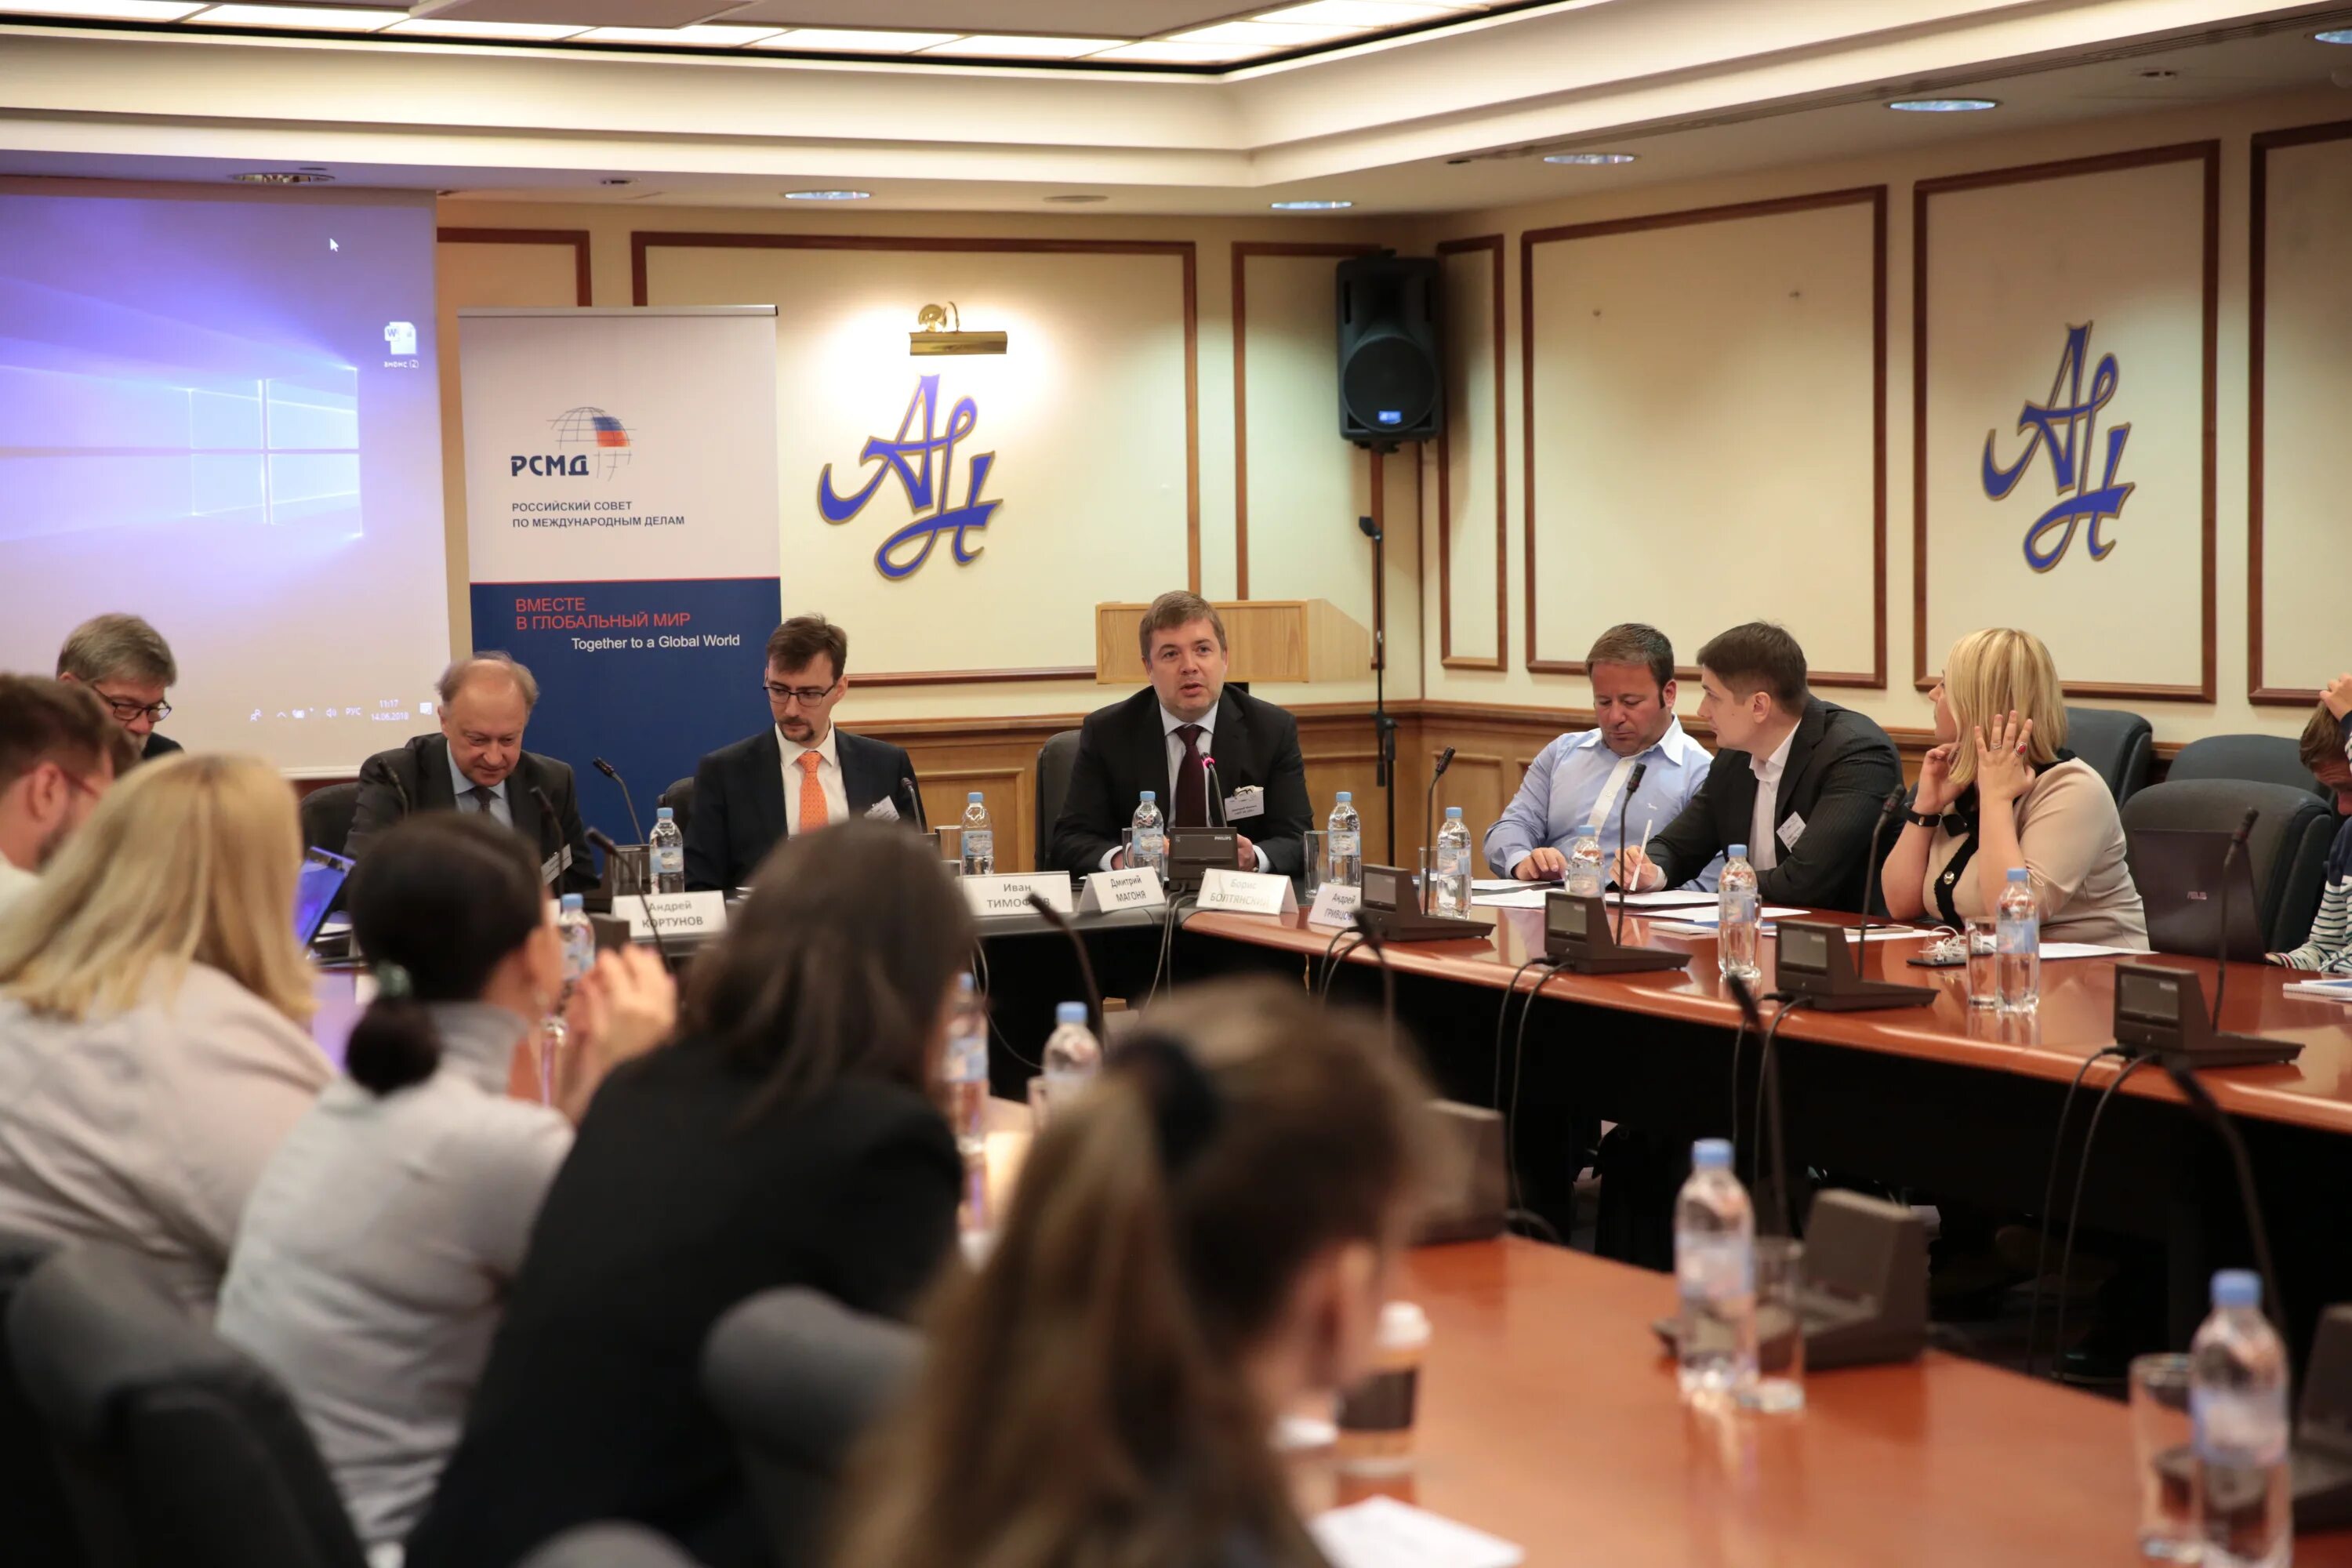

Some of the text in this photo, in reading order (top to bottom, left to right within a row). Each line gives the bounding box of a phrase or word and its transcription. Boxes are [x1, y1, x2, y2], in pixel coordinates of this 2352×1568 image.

[510, 455, 590, 477] РСМД
[512, 500, 633, 512] РОССИЙСКИЙ СОВЕТ
[512, 516, 685, 528] ПО МЕЖДУНАРОДНЫМ ДЕЛАМ
[515, 597, 586, 612] ВМЕСТЕ
[516, 611, 691, 630] В ГЛОБАЛЬНЫЙ МИР
[572, 634, 740, 652] Together to a Global World
[1004, 884, 1032, 892] Иван
[1110, 875, 1142, 889] Дмитрий
[1230, 879, 1258, 891] Борис
[1116, 891, 1147, 902] МАГОНЯ
[1332, 893, 1356, 905] Андрей
[648, 901, 692, 912] Андрей
[987, 897, 1051, 909] ТИМОФВ
